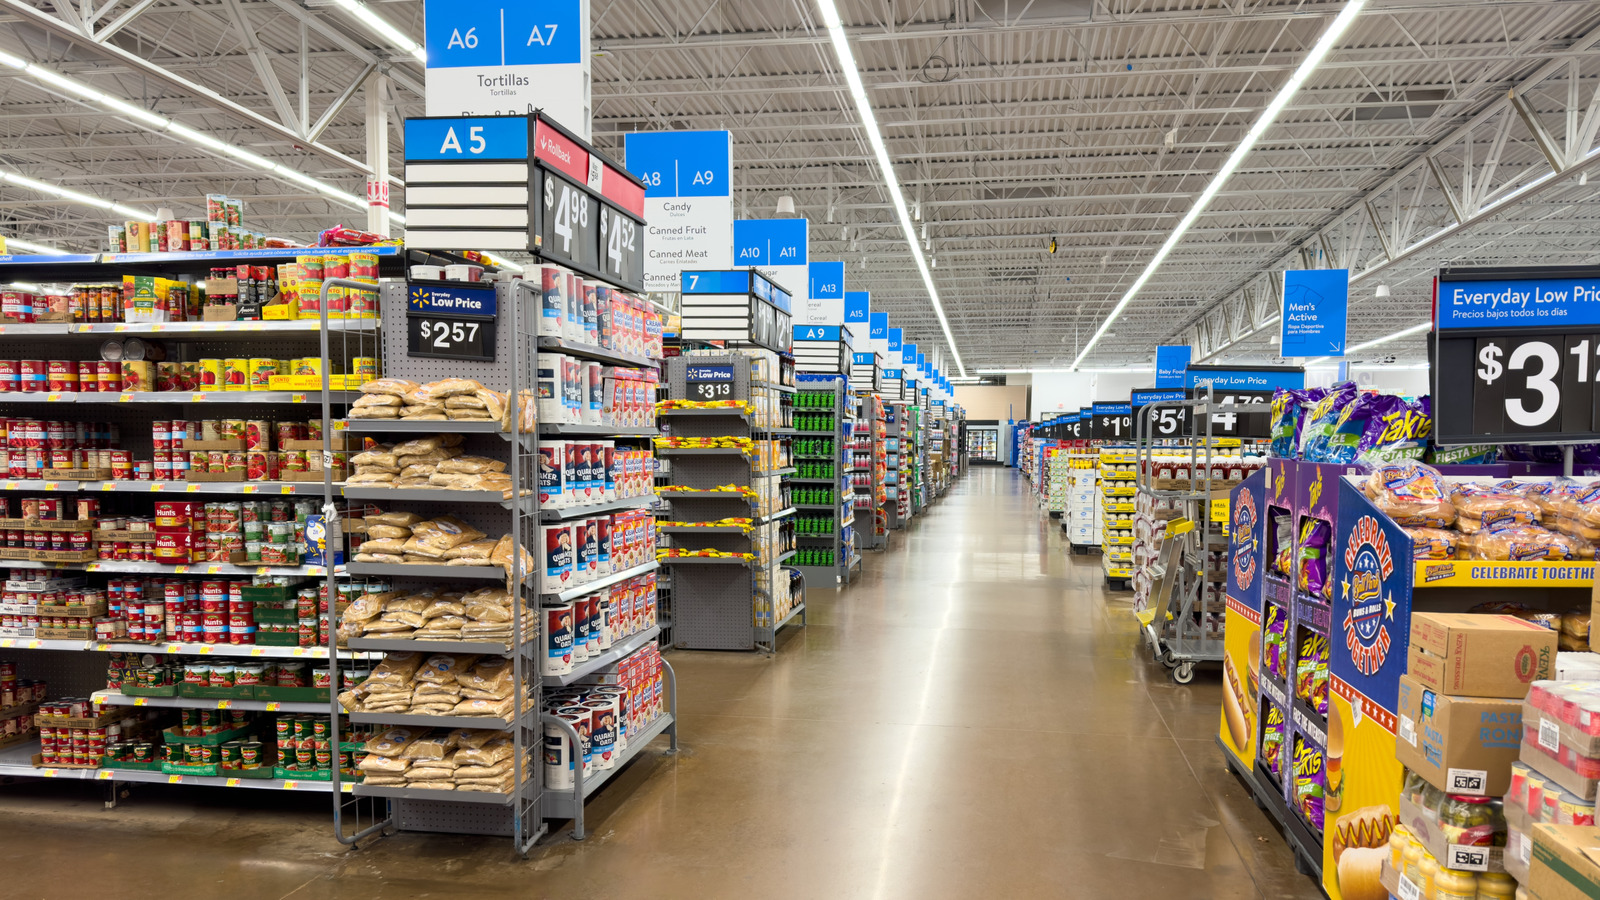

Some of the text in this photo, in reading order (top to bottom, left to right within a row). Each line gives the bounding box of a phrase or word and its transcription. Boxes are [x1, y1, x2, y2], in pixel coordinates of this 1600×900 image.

[447, 27, 479, 49] A6
[526, 24, 558, 46] A7
[477, 74, 529, 87] Tortillas
[547, 139, 571, 165] Rollback
[642, 172, 661, 186] A8
[692, 170, 714, 186] A9
[663, 202, 692, 213] Candy
[649, 226, 707, 235] Canned Fruit
[649, 250, 708, 258] Canned Meat
[740, 247, 760, 258] A10
[779, 246, 796, 257] A11
[643, 273, 677, 282] Canned
[689, 275, 699, 290] 7
[820, 284, 836, 293] A13
[431, 296, 482, 309] Low Price
[1453, 288, 1530, 309] Everyday
[1535, 287, 1568, 304] Low
[1288, 302, 1316, 311] Men's
[850, 310, 863, 318] A15
[1288, 313, 1318, 321] Active
[1453, 307, 1568, 319] Precios bajos todos los días
[699, 371, 731, 379] Low Price
[1193, 375, 1268, 386] Everyday Low Price
[1376, 409, 1431, 446] Takis
[1369, 449, 1403, 460] FIESTA
[1435, 448, 1470, 464] FIESTA
[540, 473, 557, 481] AKER
[185, 504, 191, 512] 4
[185, 535, 191, 543] 4
[1344, 515, 1394, 582] CELEBRATE
[1471, 566, 1539, 580] CELEBRATE
[1353, 608, 1365, 618] BUNS
[1369, 603, 1382, 614] ROLLS
[1342, 609, 1392, 676] TOGETHER
